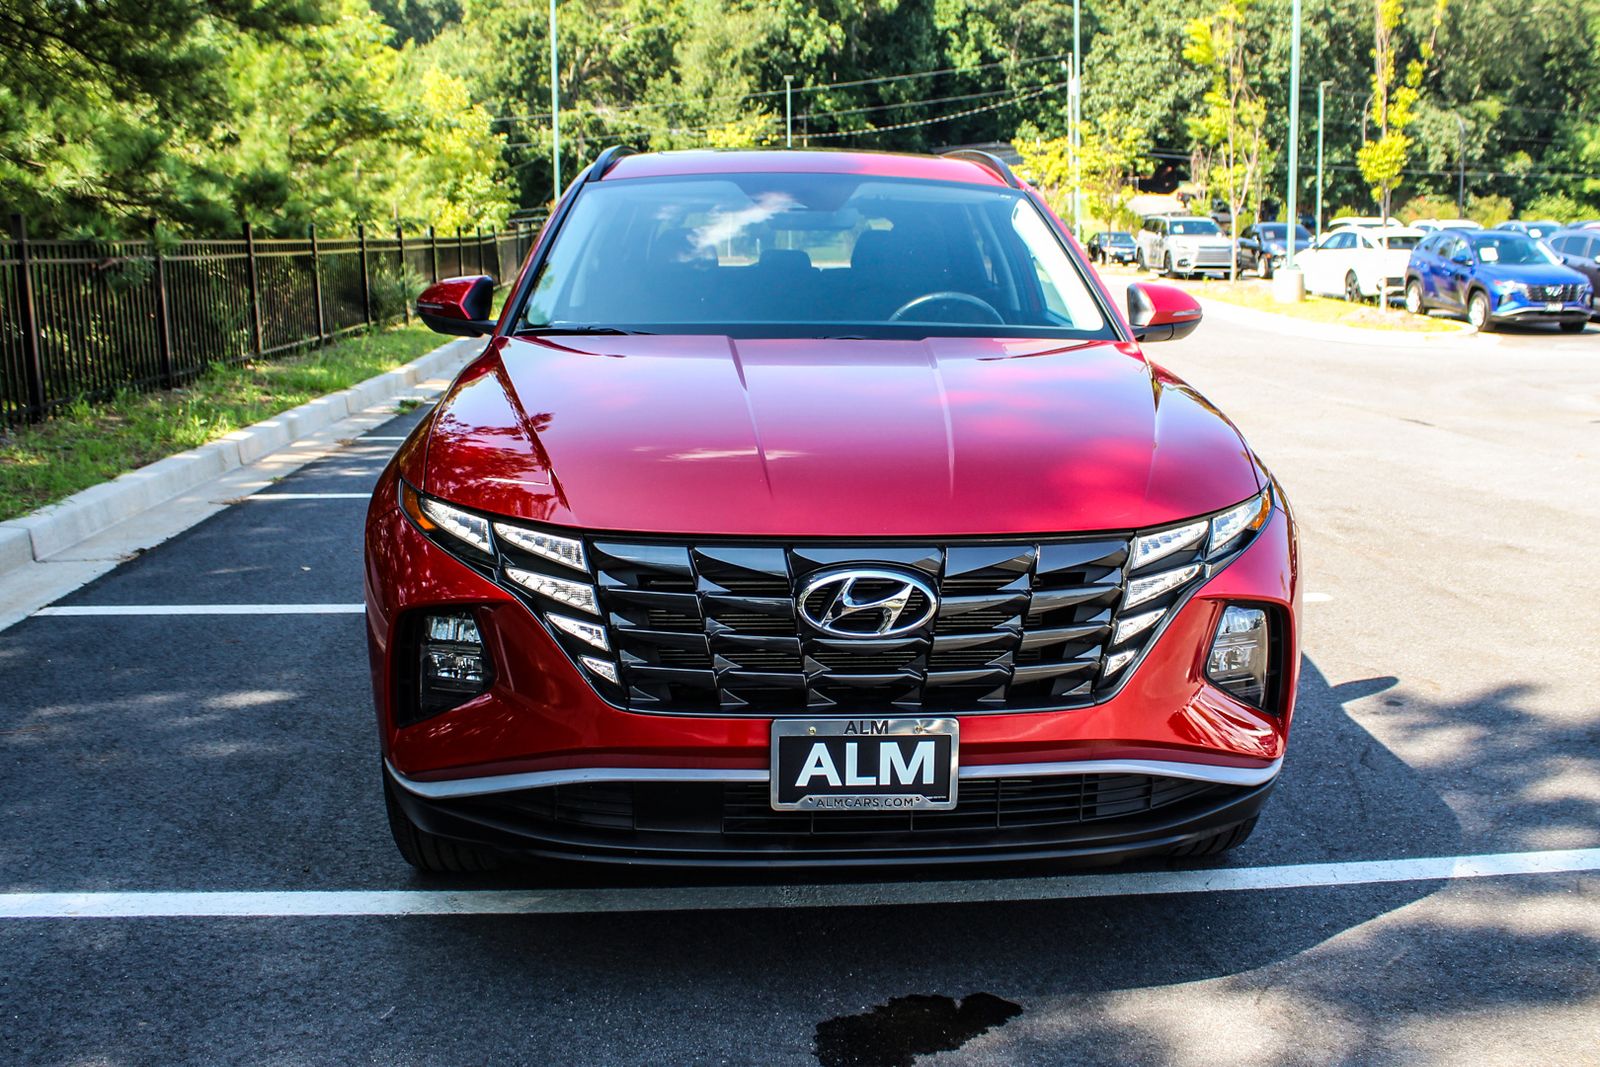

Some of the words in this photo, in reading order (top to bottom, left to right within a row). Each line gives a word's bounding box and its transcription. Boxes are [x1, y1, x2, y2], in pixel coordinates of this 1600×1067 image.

[844, 720, 889, 735] ALM
[795, 741, 936, 787] ALM
[816, 797, 914, 808] ALMCARS.COM
